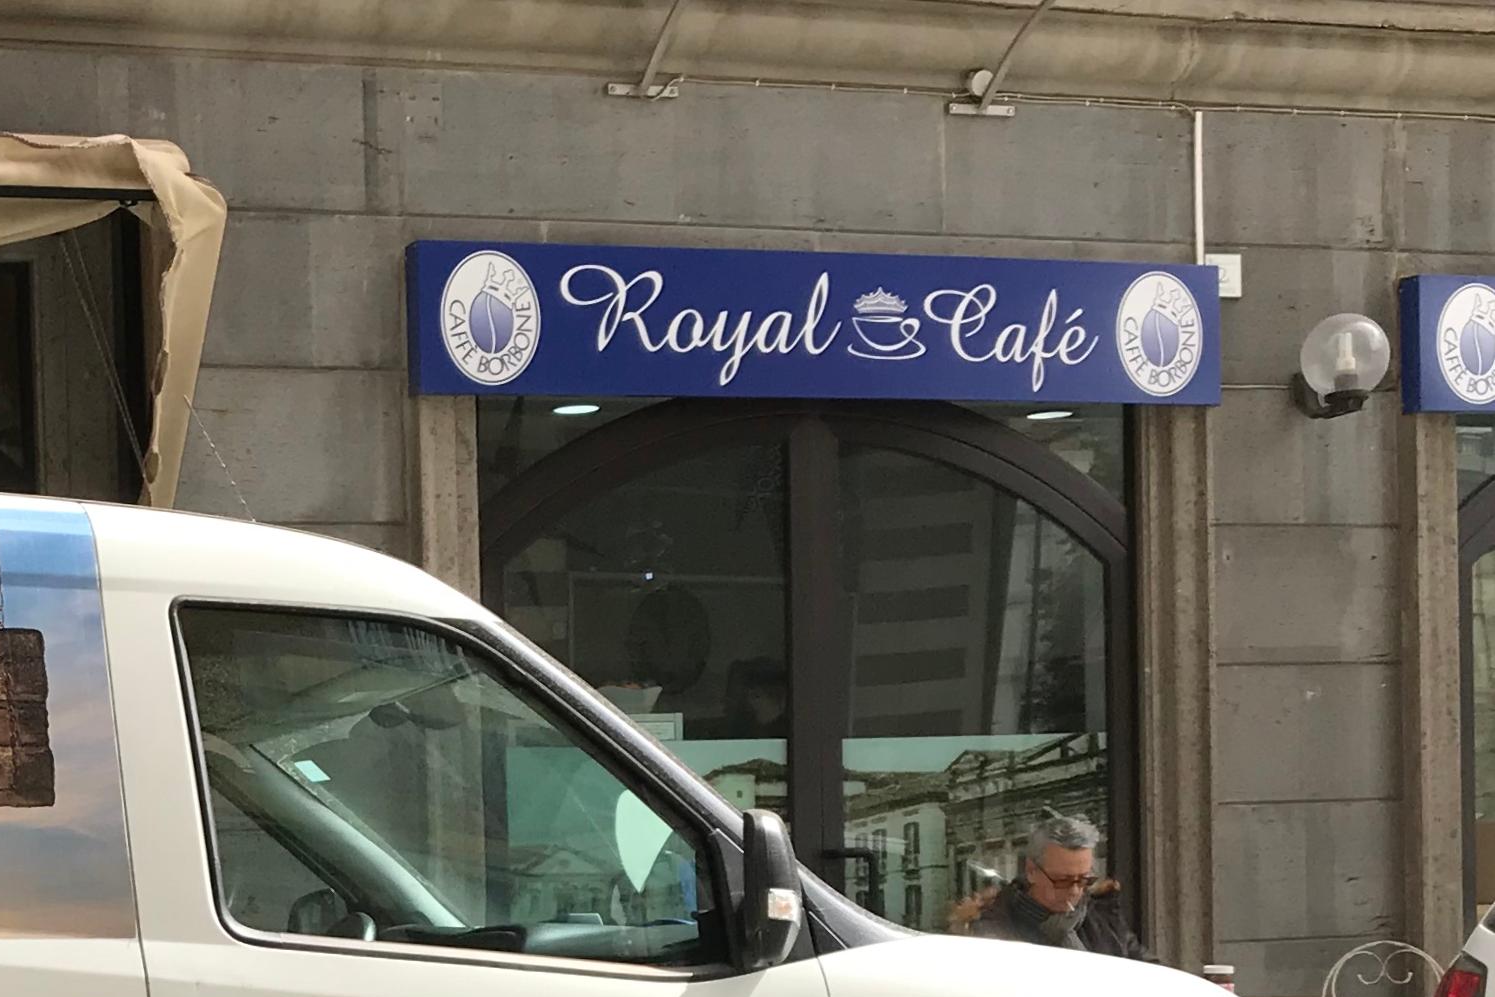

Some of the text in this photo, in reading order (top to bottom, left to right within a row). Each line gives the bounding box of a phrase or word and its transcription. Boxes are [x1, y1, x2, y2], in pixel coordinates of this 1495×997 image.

[476, 301, 533, 376] BORBONE
[559, 264, 1100, 393] Royal Café
[1147, 318, 1196, 388] BORBONE
